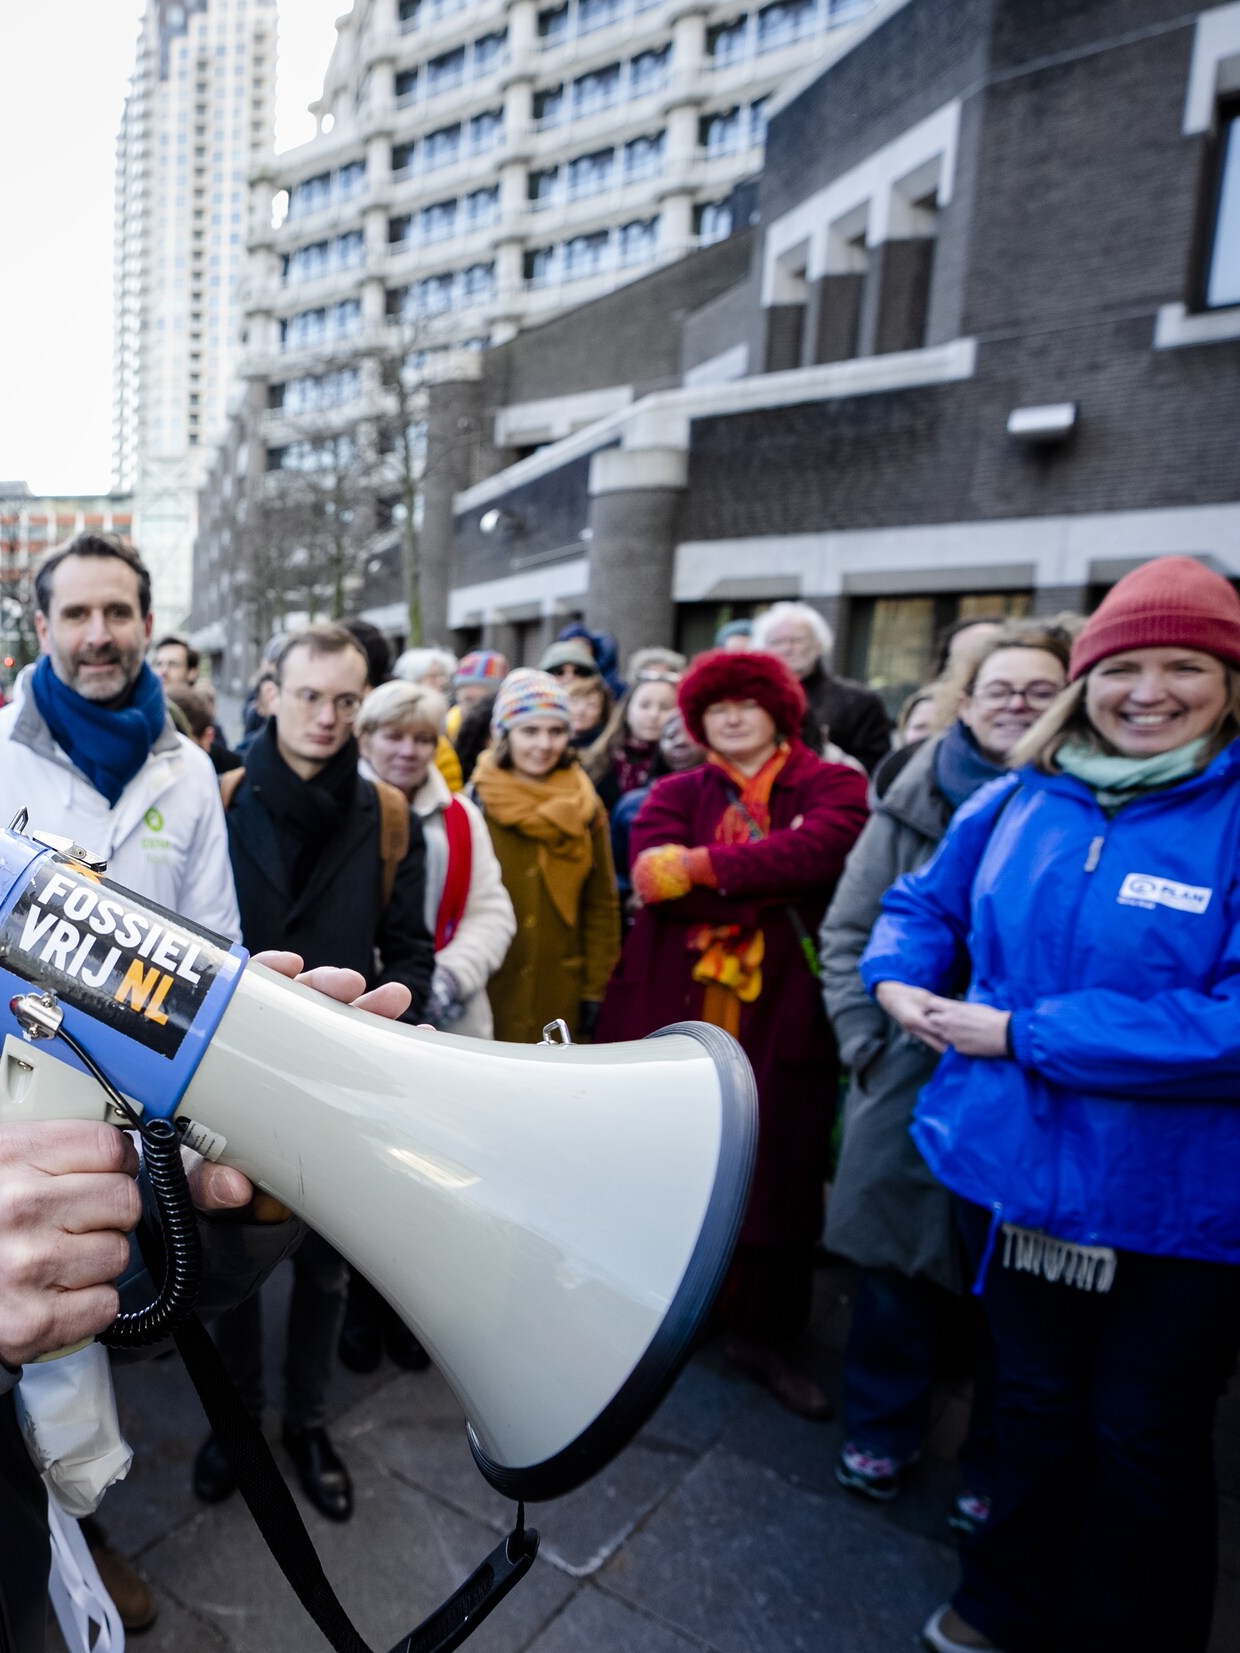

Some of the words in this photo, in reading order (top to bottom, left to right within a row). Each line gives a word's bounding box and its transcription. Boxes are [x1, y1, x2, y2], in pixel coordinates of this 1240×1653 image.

[18, 903, 122, 988] VRIJ
[113, 958, 175, 1026] NL
[37, 872, 202, 985] FOSSIEL
